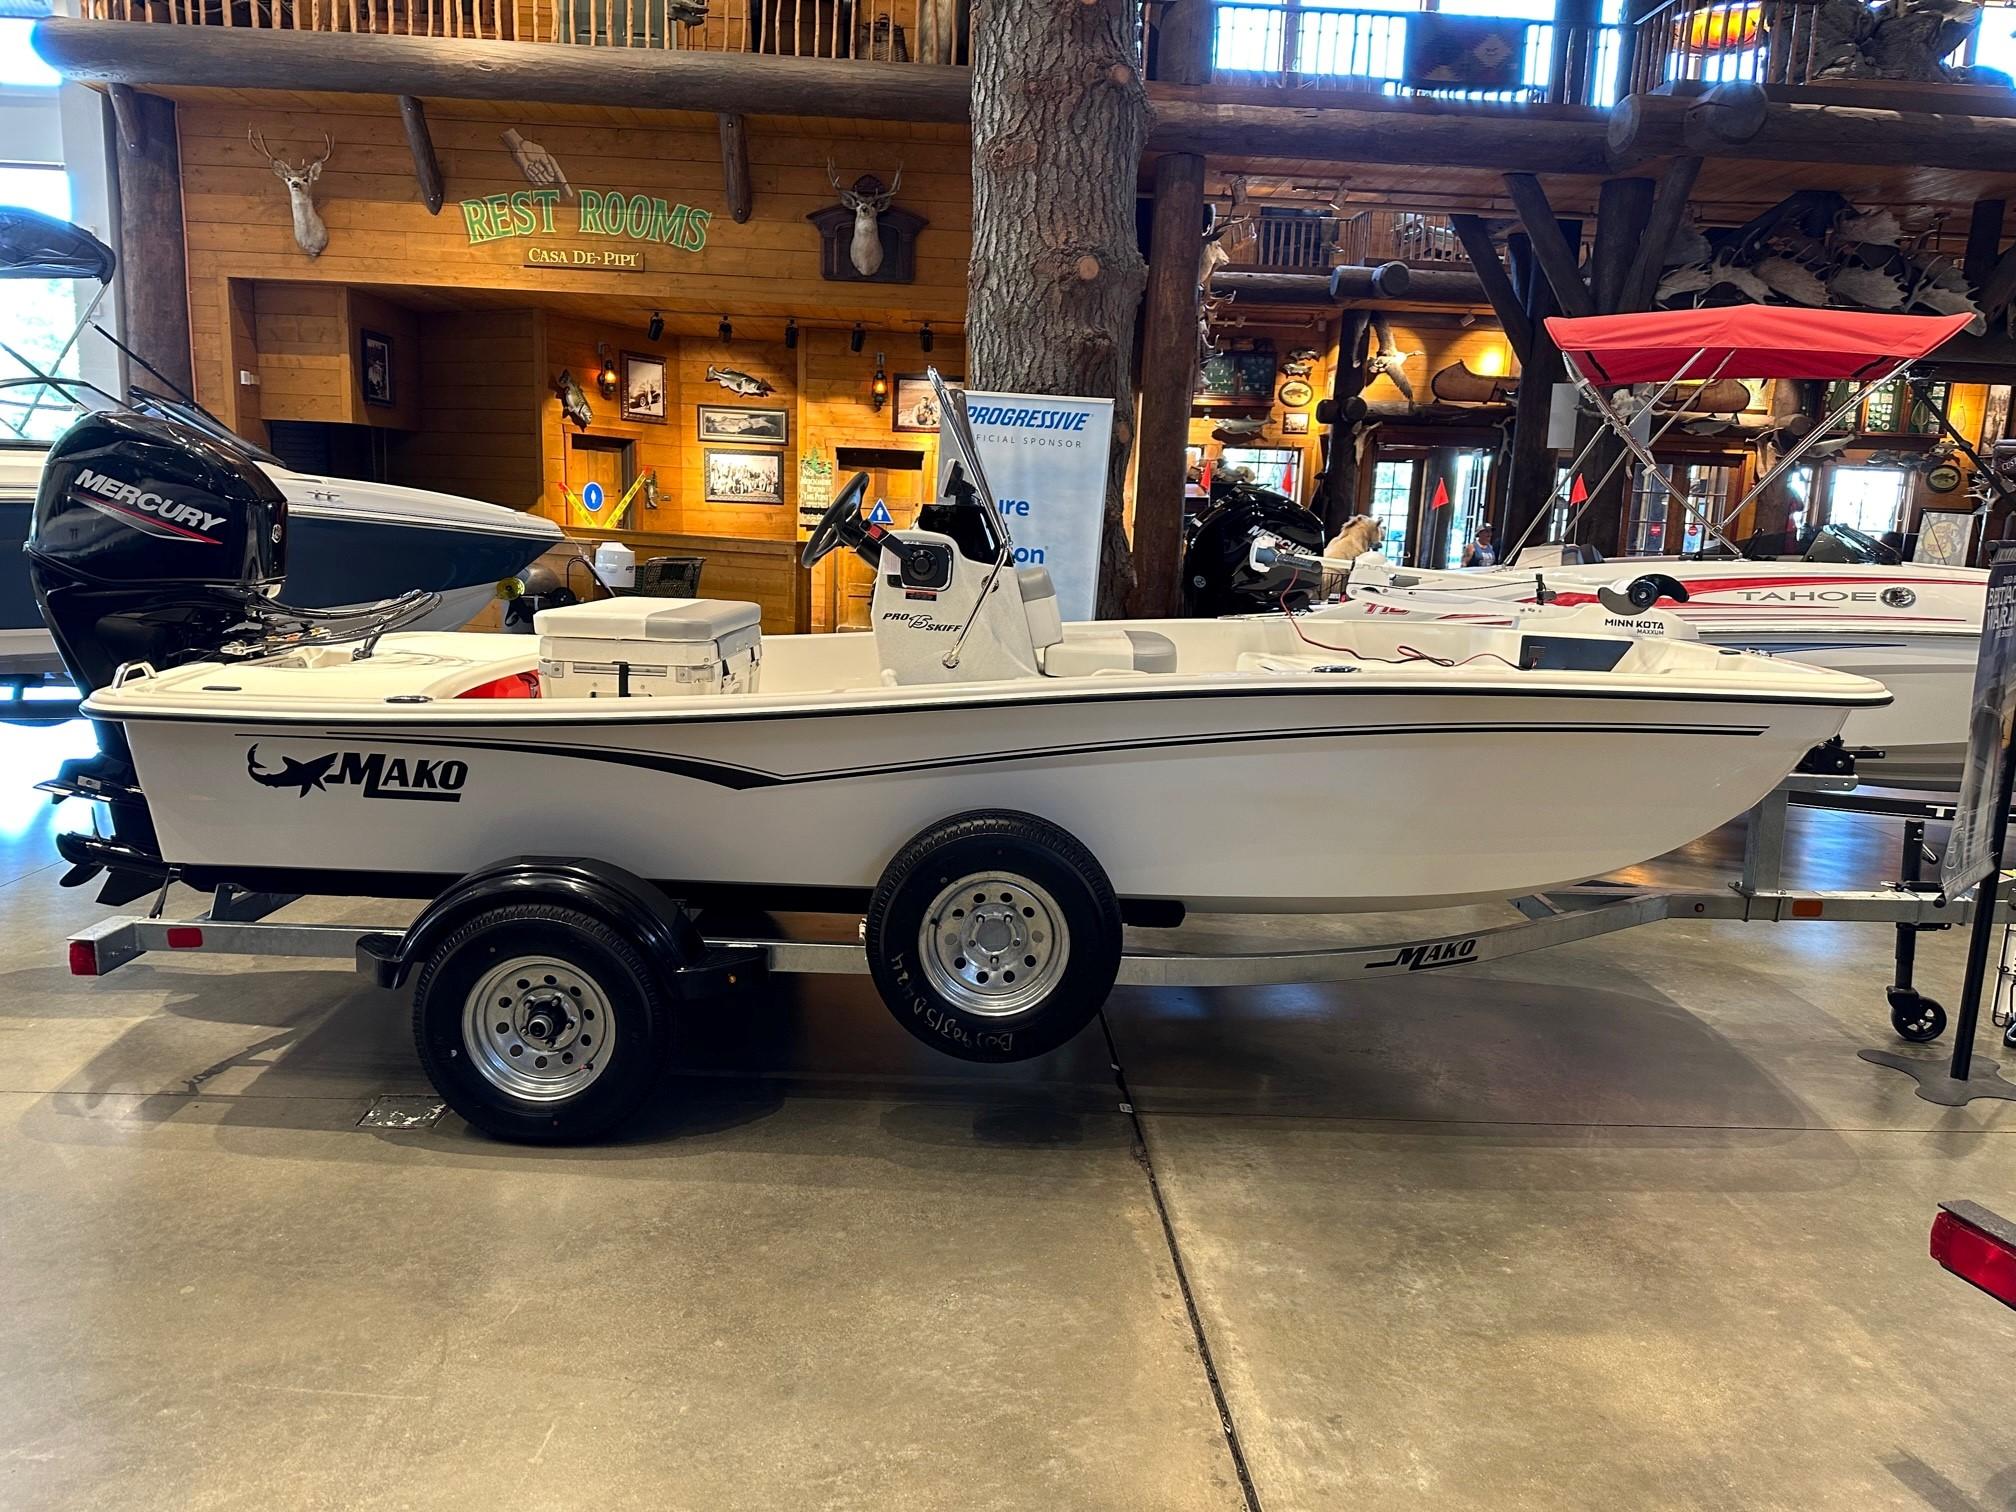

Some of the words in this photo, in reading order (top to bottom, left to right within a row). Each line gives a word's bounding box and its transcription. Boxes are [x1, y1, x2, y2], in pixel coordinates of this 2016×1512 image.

[460, 189, 560, 245] REST
[578, 189, 712, 253] ROOMS
[528, 247, 568, 264] CASA
[967, 405, 1090, 431] PROGRESSIVE
[975, 433, 1015, 444] FICIAL
[1023, 437, 1082, 448] SPONSOR
[74, 468, 227, 532] MERCURY
[1013, 547, 1045, 564] on
[1736, 591, 1877, 602] TAHOE
[882, 612, 910, 621] PRO
[908, 614, 933, 629] 15
[925, 624, 963, 632] SKIFF
[1604, 618, 1634, 628] MINN
[1635, 620, 1665, 630] KOTA
[1636, 628, 1665, 636] MAXXUM
[322, 751, 469, 803] MAKO
[1364, 939, 1479, 972] MAKO
